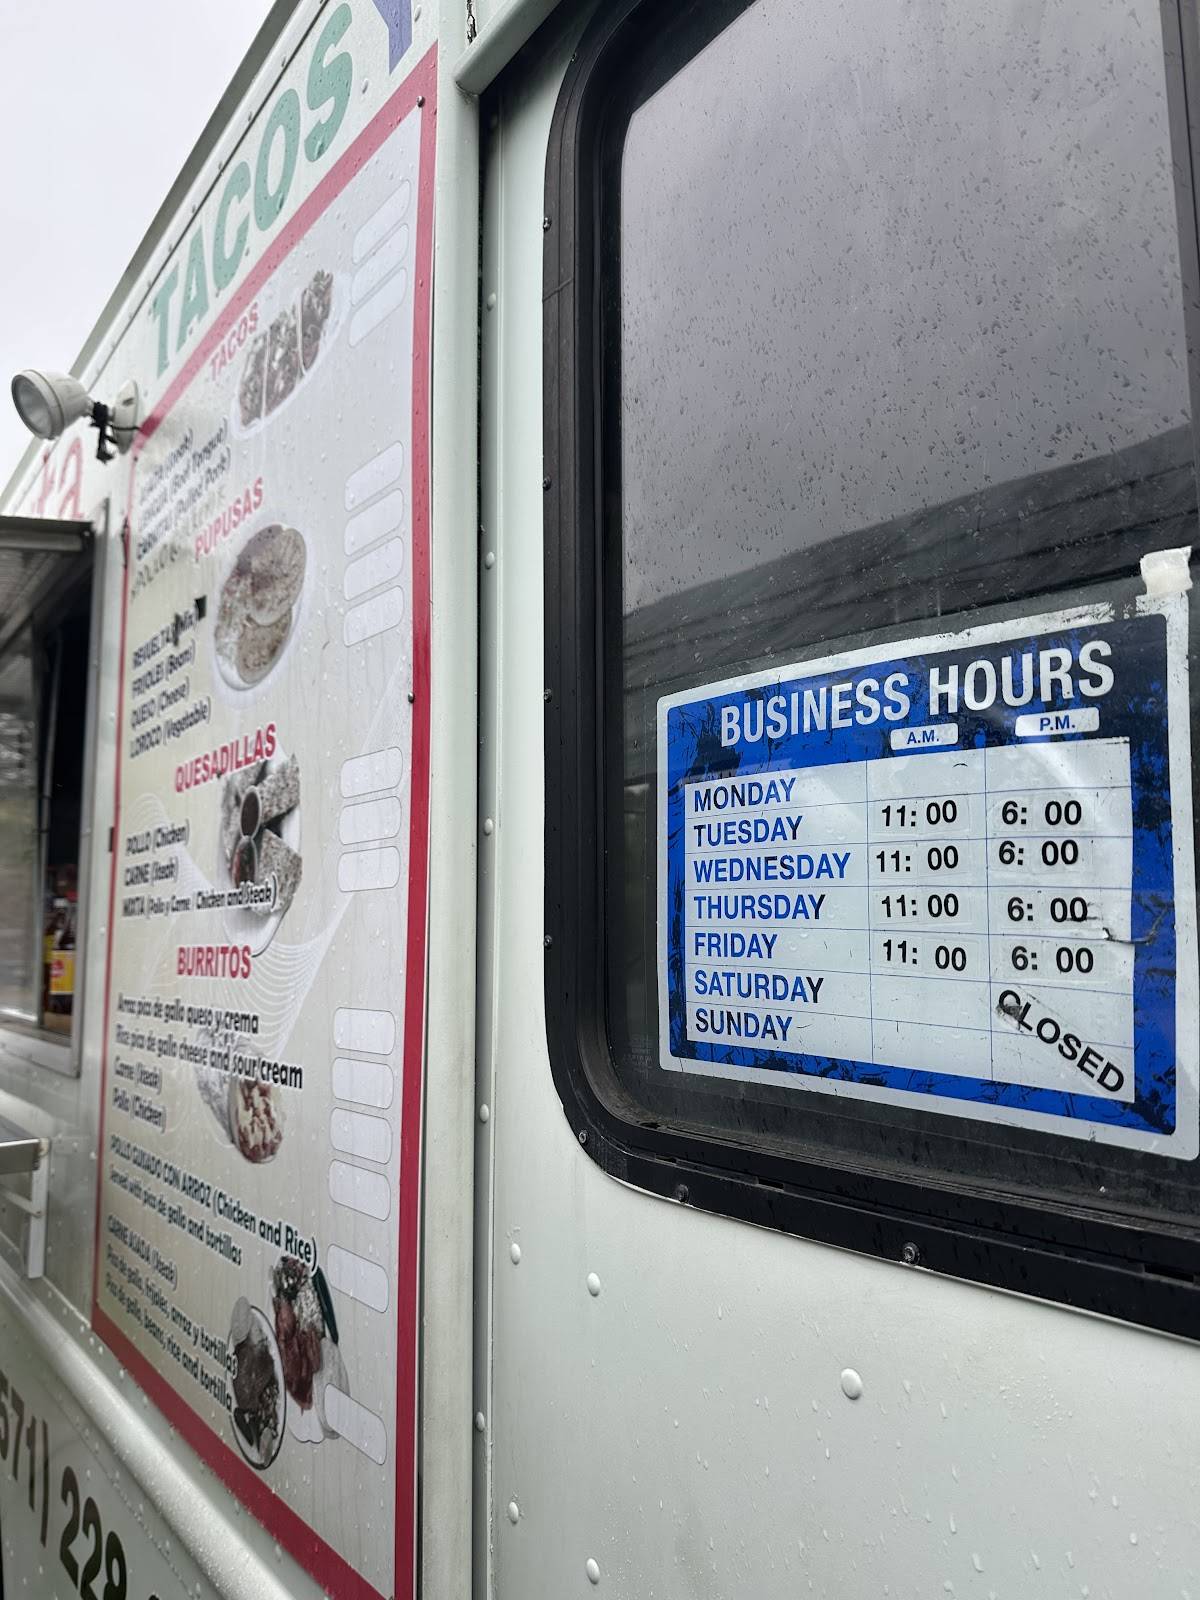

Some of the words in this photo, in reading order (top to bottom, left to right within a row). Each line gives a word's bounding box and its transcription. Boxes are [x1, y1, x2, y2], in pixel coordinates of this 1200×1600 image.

[149, 3, 353, 380] TACOS
[210, 302, 260, 380] TACOS
[194, 476, 263, 563] PUPUSAS
[720, 672, 910, 748] BUSINESS
[929, 640, 1115, 716] HOURS
[907, 729, 941, 745] A.M.
[1039, 713, 1077, 732] P.M.
[175, 723, 276, 793] QUESADILLAS
[693, 777, 796, 812] MONDAY
[693, 815, 803, 848] TUESDAY
[881, 804, 918, 828] 11:
[926, 799, 957, 825] 00
[1001, 800, 1028, 826] 6:
[1044, 800, 1082, 826] 00
[693, 851, 851, 883] WEDNESDAY
[875, 849, 912, 874] 11:
[927, 845, 959, 871] 00
[998, 840, 1025, 866] 6:
[1041, 839, 1079, 865] 00
[693, 893, 826, 921] THURSDAY
[881, 895, 918, 919] 11:
[927, 893, 959, 918] 00
[1007, 897, 1034, 922] 6:
[1050, 896, 1089, 923] 00
[177, 945, 252, 979] BURRITOS
[694, 932, 778, 960] FRIDAY
[882, 939, 918, 965] 11:
[934, 945, 967, 971] 00
[1011, 945, 1038, 971] 6:
[1055, 947, 1094, 973] 00
[694, 969, 824, 1005] SATURDAY
[164, 998, 185, 1023] gallo
[187, 1005, 214, 1029] queso
[215, 1012, 223, 1032] y
[224, 1010, 259, 1034] crema
[695, 1008, 793, 1042] SUNDAY
[158, 1033, 178, 1058] gallo
[179, 1039, 208, 1065] cheese
[210, 1046, 231, 1072] and
[232, 1053, 257, 1078] sour
[260, 1058, 303, 1089] cream
[998, 988, 1125, 1093] CLOSED
[181, 1173, 212, 1208] ARROZ
[213, 1189, 257, 1235] (Chicken
[259, 1218, 282, 1247] and
[285, 1225, 319, 1272] Rice)
[188, 1218, 204, 1242] and
[206, 1225, 243, 1266] tortillas
[193, 1325, 199, 1347] y
[182, 1355, 199, 1379] and
